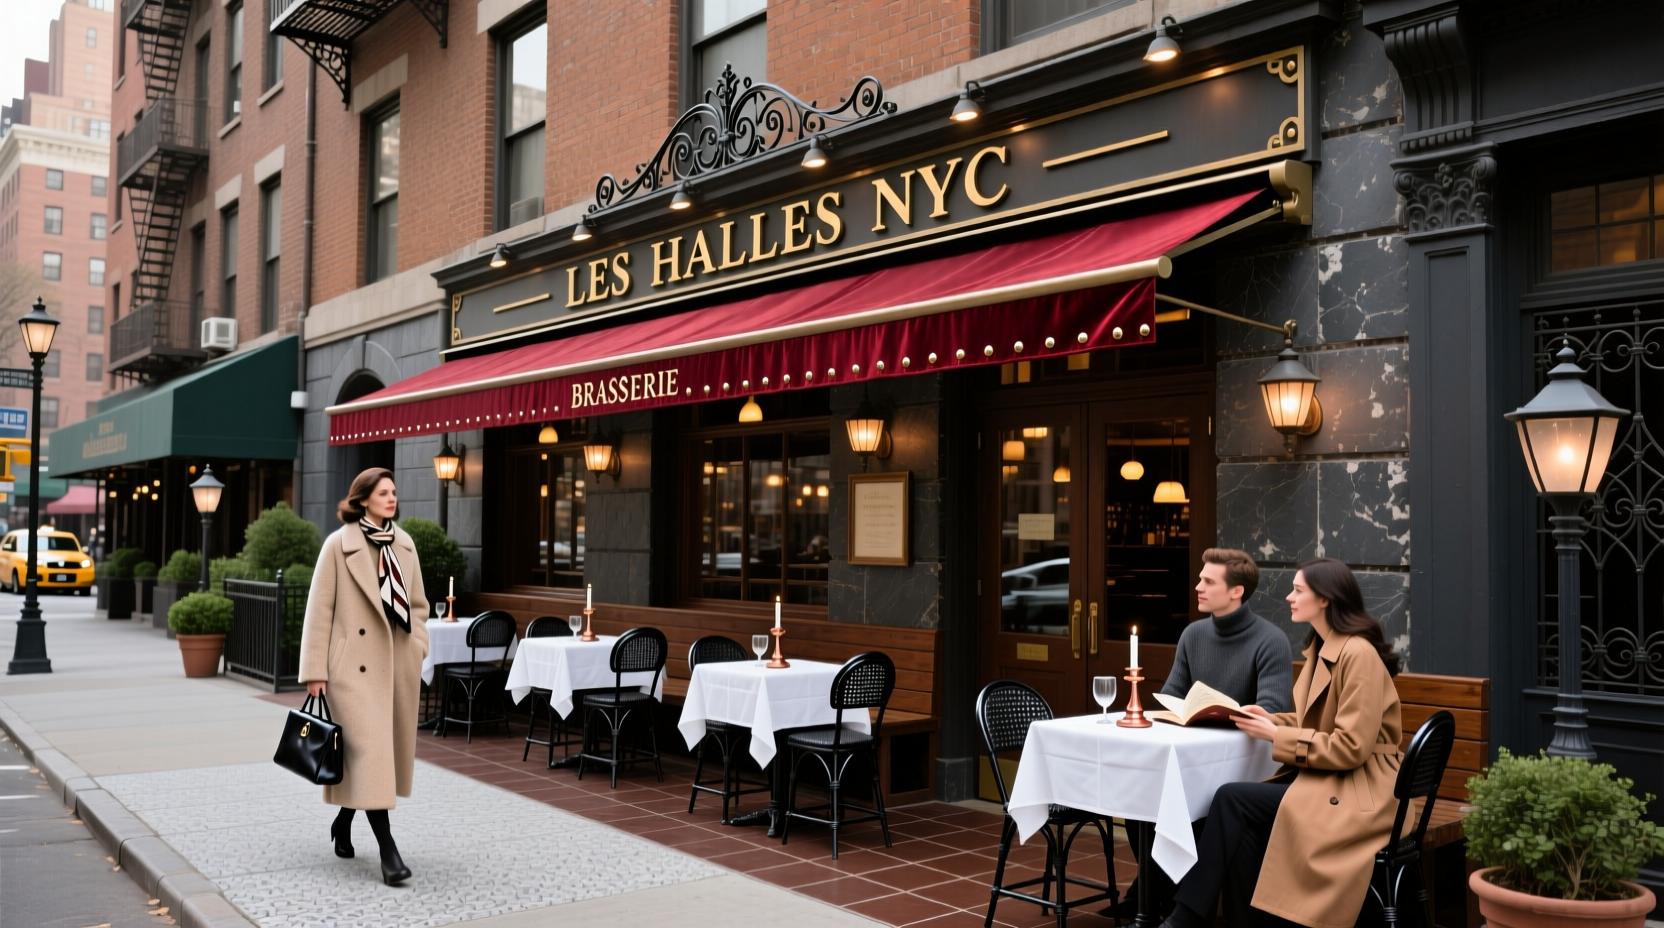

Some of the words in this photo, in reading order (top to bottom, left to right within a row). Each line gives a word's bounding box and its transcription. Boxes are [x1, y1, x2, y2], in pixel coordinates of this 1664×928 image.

[565, 251, 632, 308] LES
[650, 191, 844, 287] HALLES
[871, 145, 1009, 232] NYC
[571, 368, 679, 408] BRASSERIE
